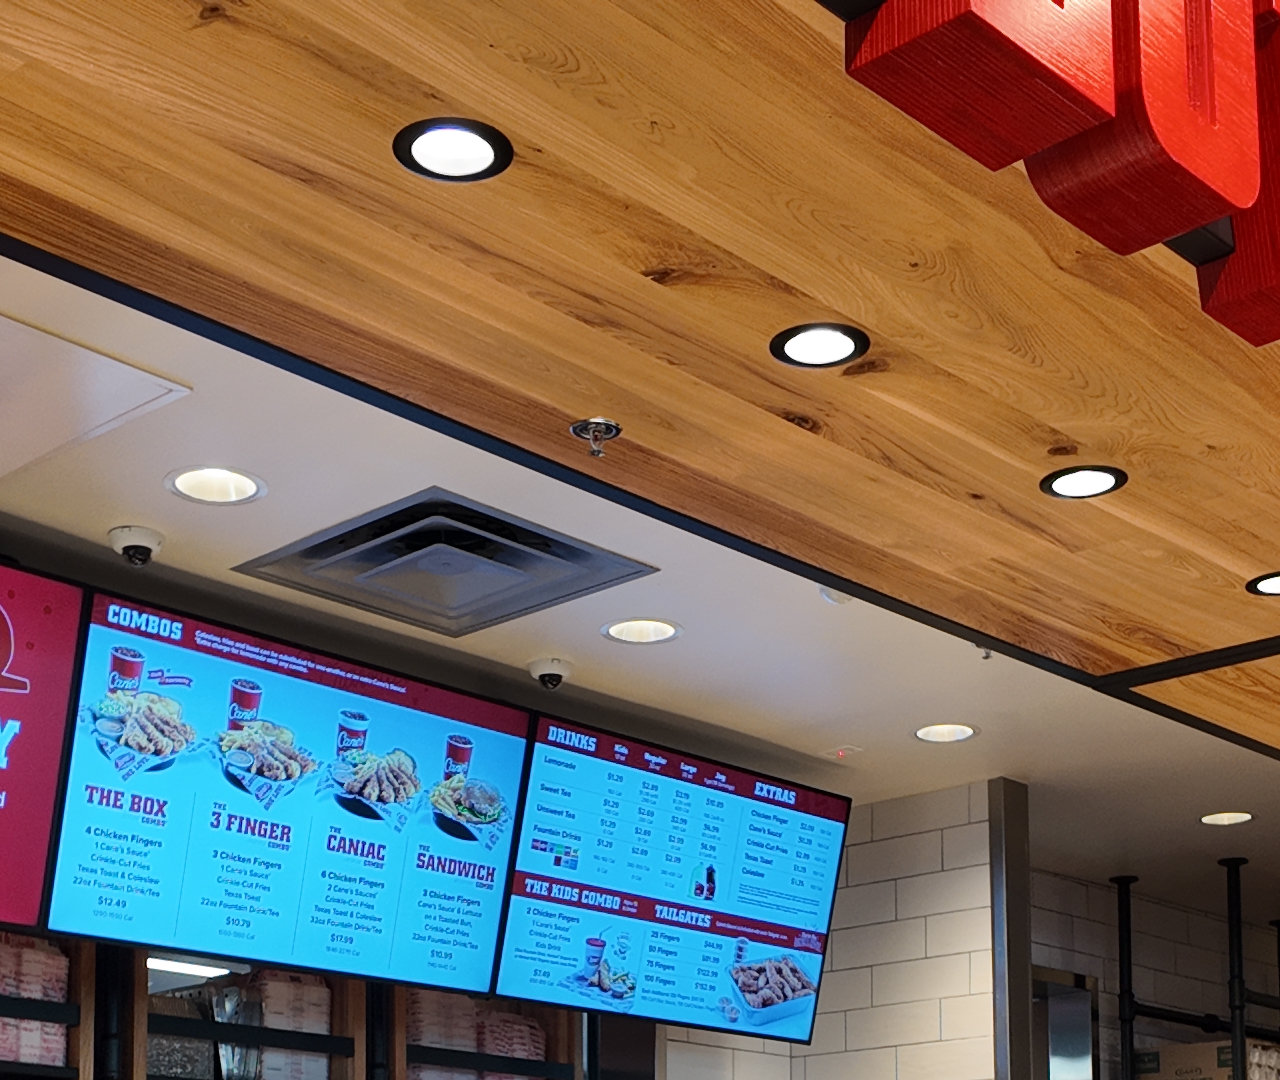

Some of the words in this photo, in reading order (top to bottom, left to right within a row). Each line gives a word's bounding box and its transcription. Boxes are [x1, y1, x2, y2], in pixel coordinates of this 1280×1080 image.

[107, 604, 183, 641] COMBOS
[547, 725, 597, 752] DRINKS
[543, 755, 577, 770] Lemonade
[84, 784, 125, 810] THE
[129, 794, 168, 818] BOX
[754, 781, 797, 804] EXTRAS
[85, 826, 91, 835] 4
[93, 827, 129, 843] Chicken
[131, 834, 163, 848] Fingers
[210, 811, 221, 829] 3
[225, 813, 291, 843] FINGER
[212, 850, 218, 859] 3
[220, 851, 251, 864] Chicken
[253, 857, 282, 870] Fingers
[326, 834, 387, 861] CANIAC
[328, 871, 357, 884] Chicken
[358, 876, 385, 889] Fingers
[416, 852, 497, 883] SANDWICH
[428, 890, 456, 902] Chicken
[524, 878, 550, 896] THE
[550, 884, 580, 901] KIDS
[581, 890, 621, 910] COMBO
[654, 904, 711, 928] TAILGATES
